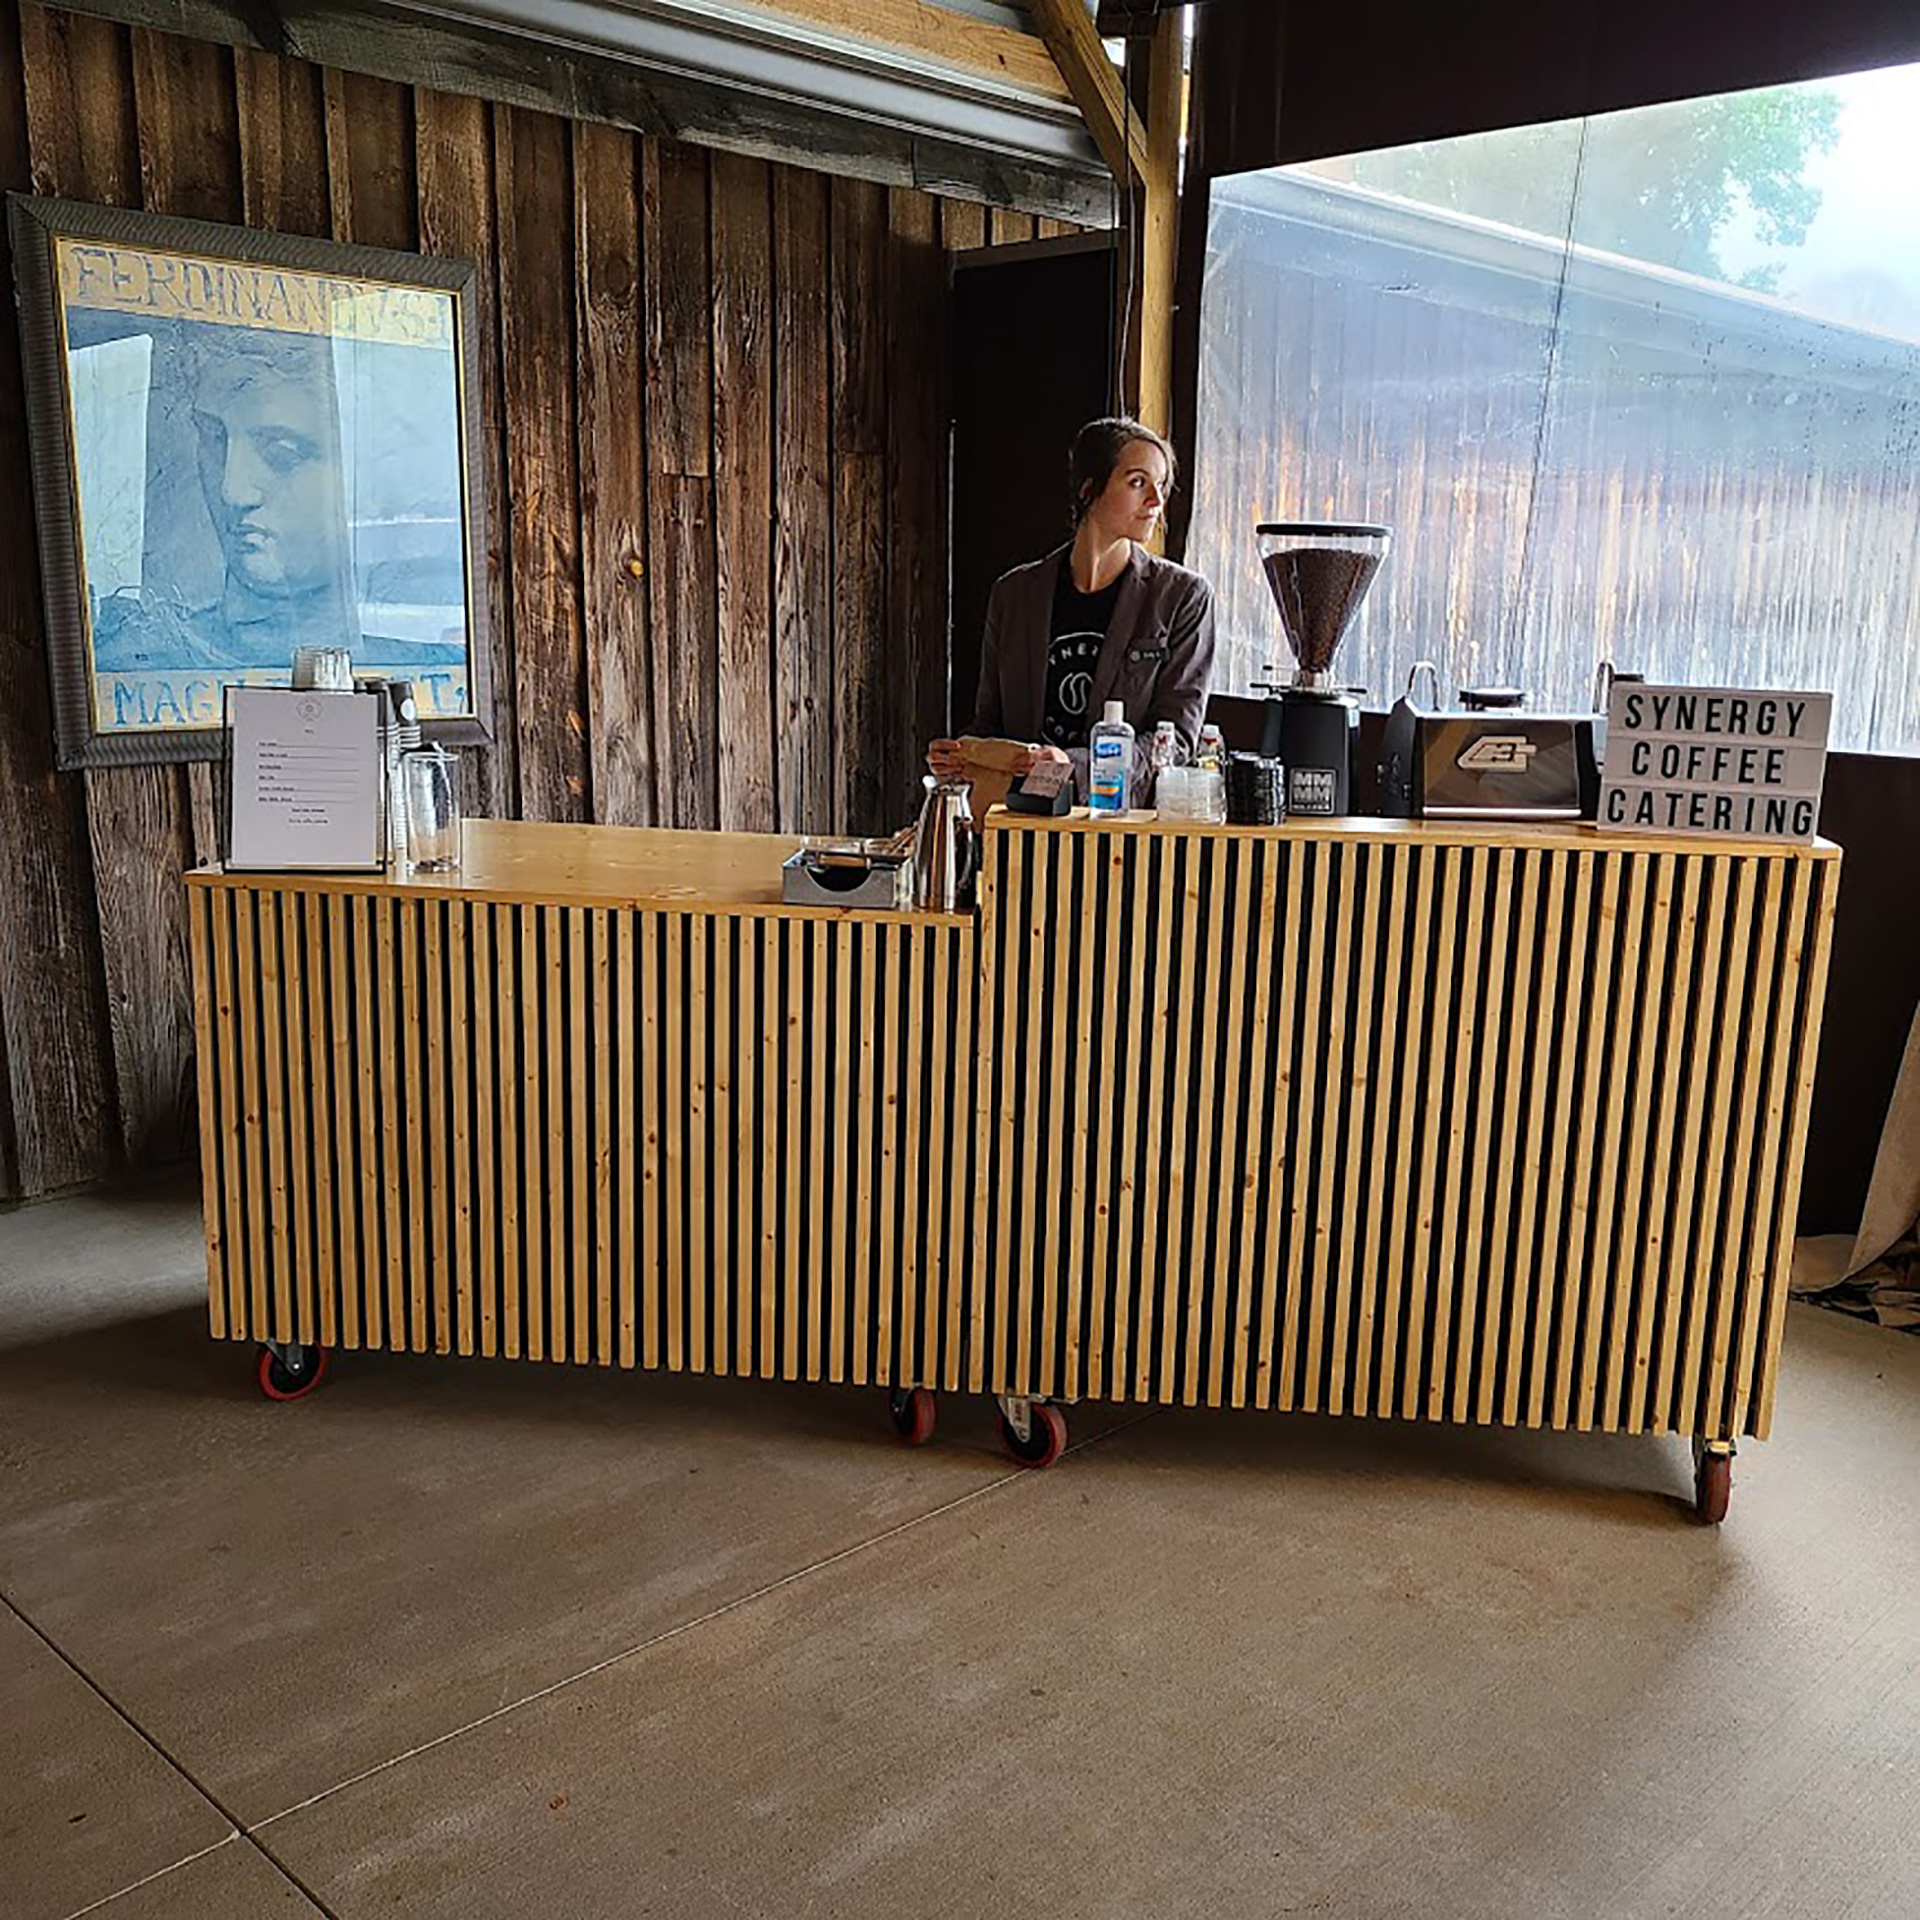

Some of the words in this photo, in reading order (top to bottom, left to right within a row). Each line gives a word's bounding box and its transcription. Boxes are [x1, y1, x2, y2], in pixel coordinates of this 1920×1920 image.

[1625, 694, 1806, 738] SYNERGY
[1632, 741, 1785, 784] COFFEE
[1607, 788, 1813, 836] CATERING
